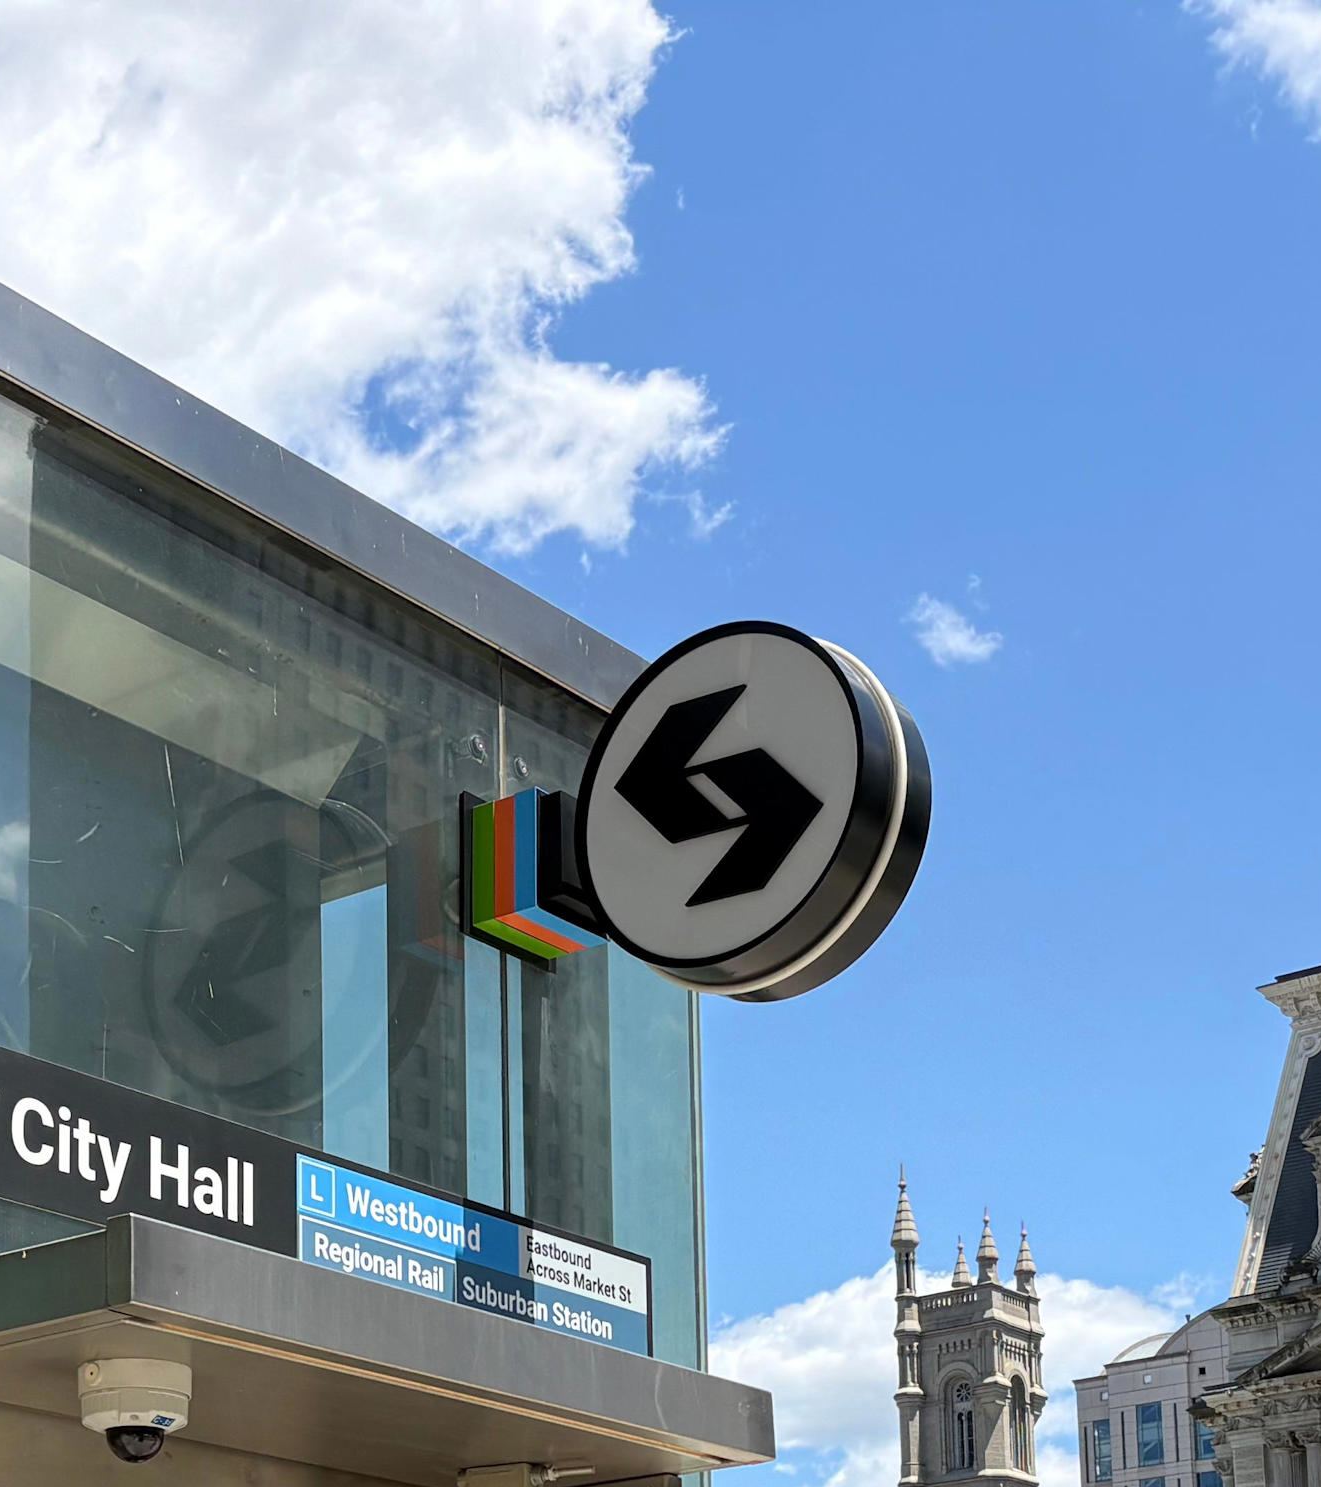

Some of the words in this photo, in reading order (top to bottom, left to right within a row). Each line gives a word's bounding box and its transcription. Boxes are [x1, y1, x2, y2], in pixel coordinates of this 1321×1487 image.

[11, 1097, 132, 1204] City
[149, 1135, 254, 1226] Hall
[310, 1174, 324, 1202] L
[345, 1182, 481, 1253] Westbound
[313, 1232, 403, 1281] Regional
[407, 1261, 445, 1293] Rail
[526, 1235, 592, 1271] Eastbound
[526, 1256, 571, 1286] Across
[573, 1274, 617, 1300] Market
[618, 1284, 632, 1304] St
[462, 1276, 549, 1322] Suburban
[552, 1302, 613, 1341] Station
